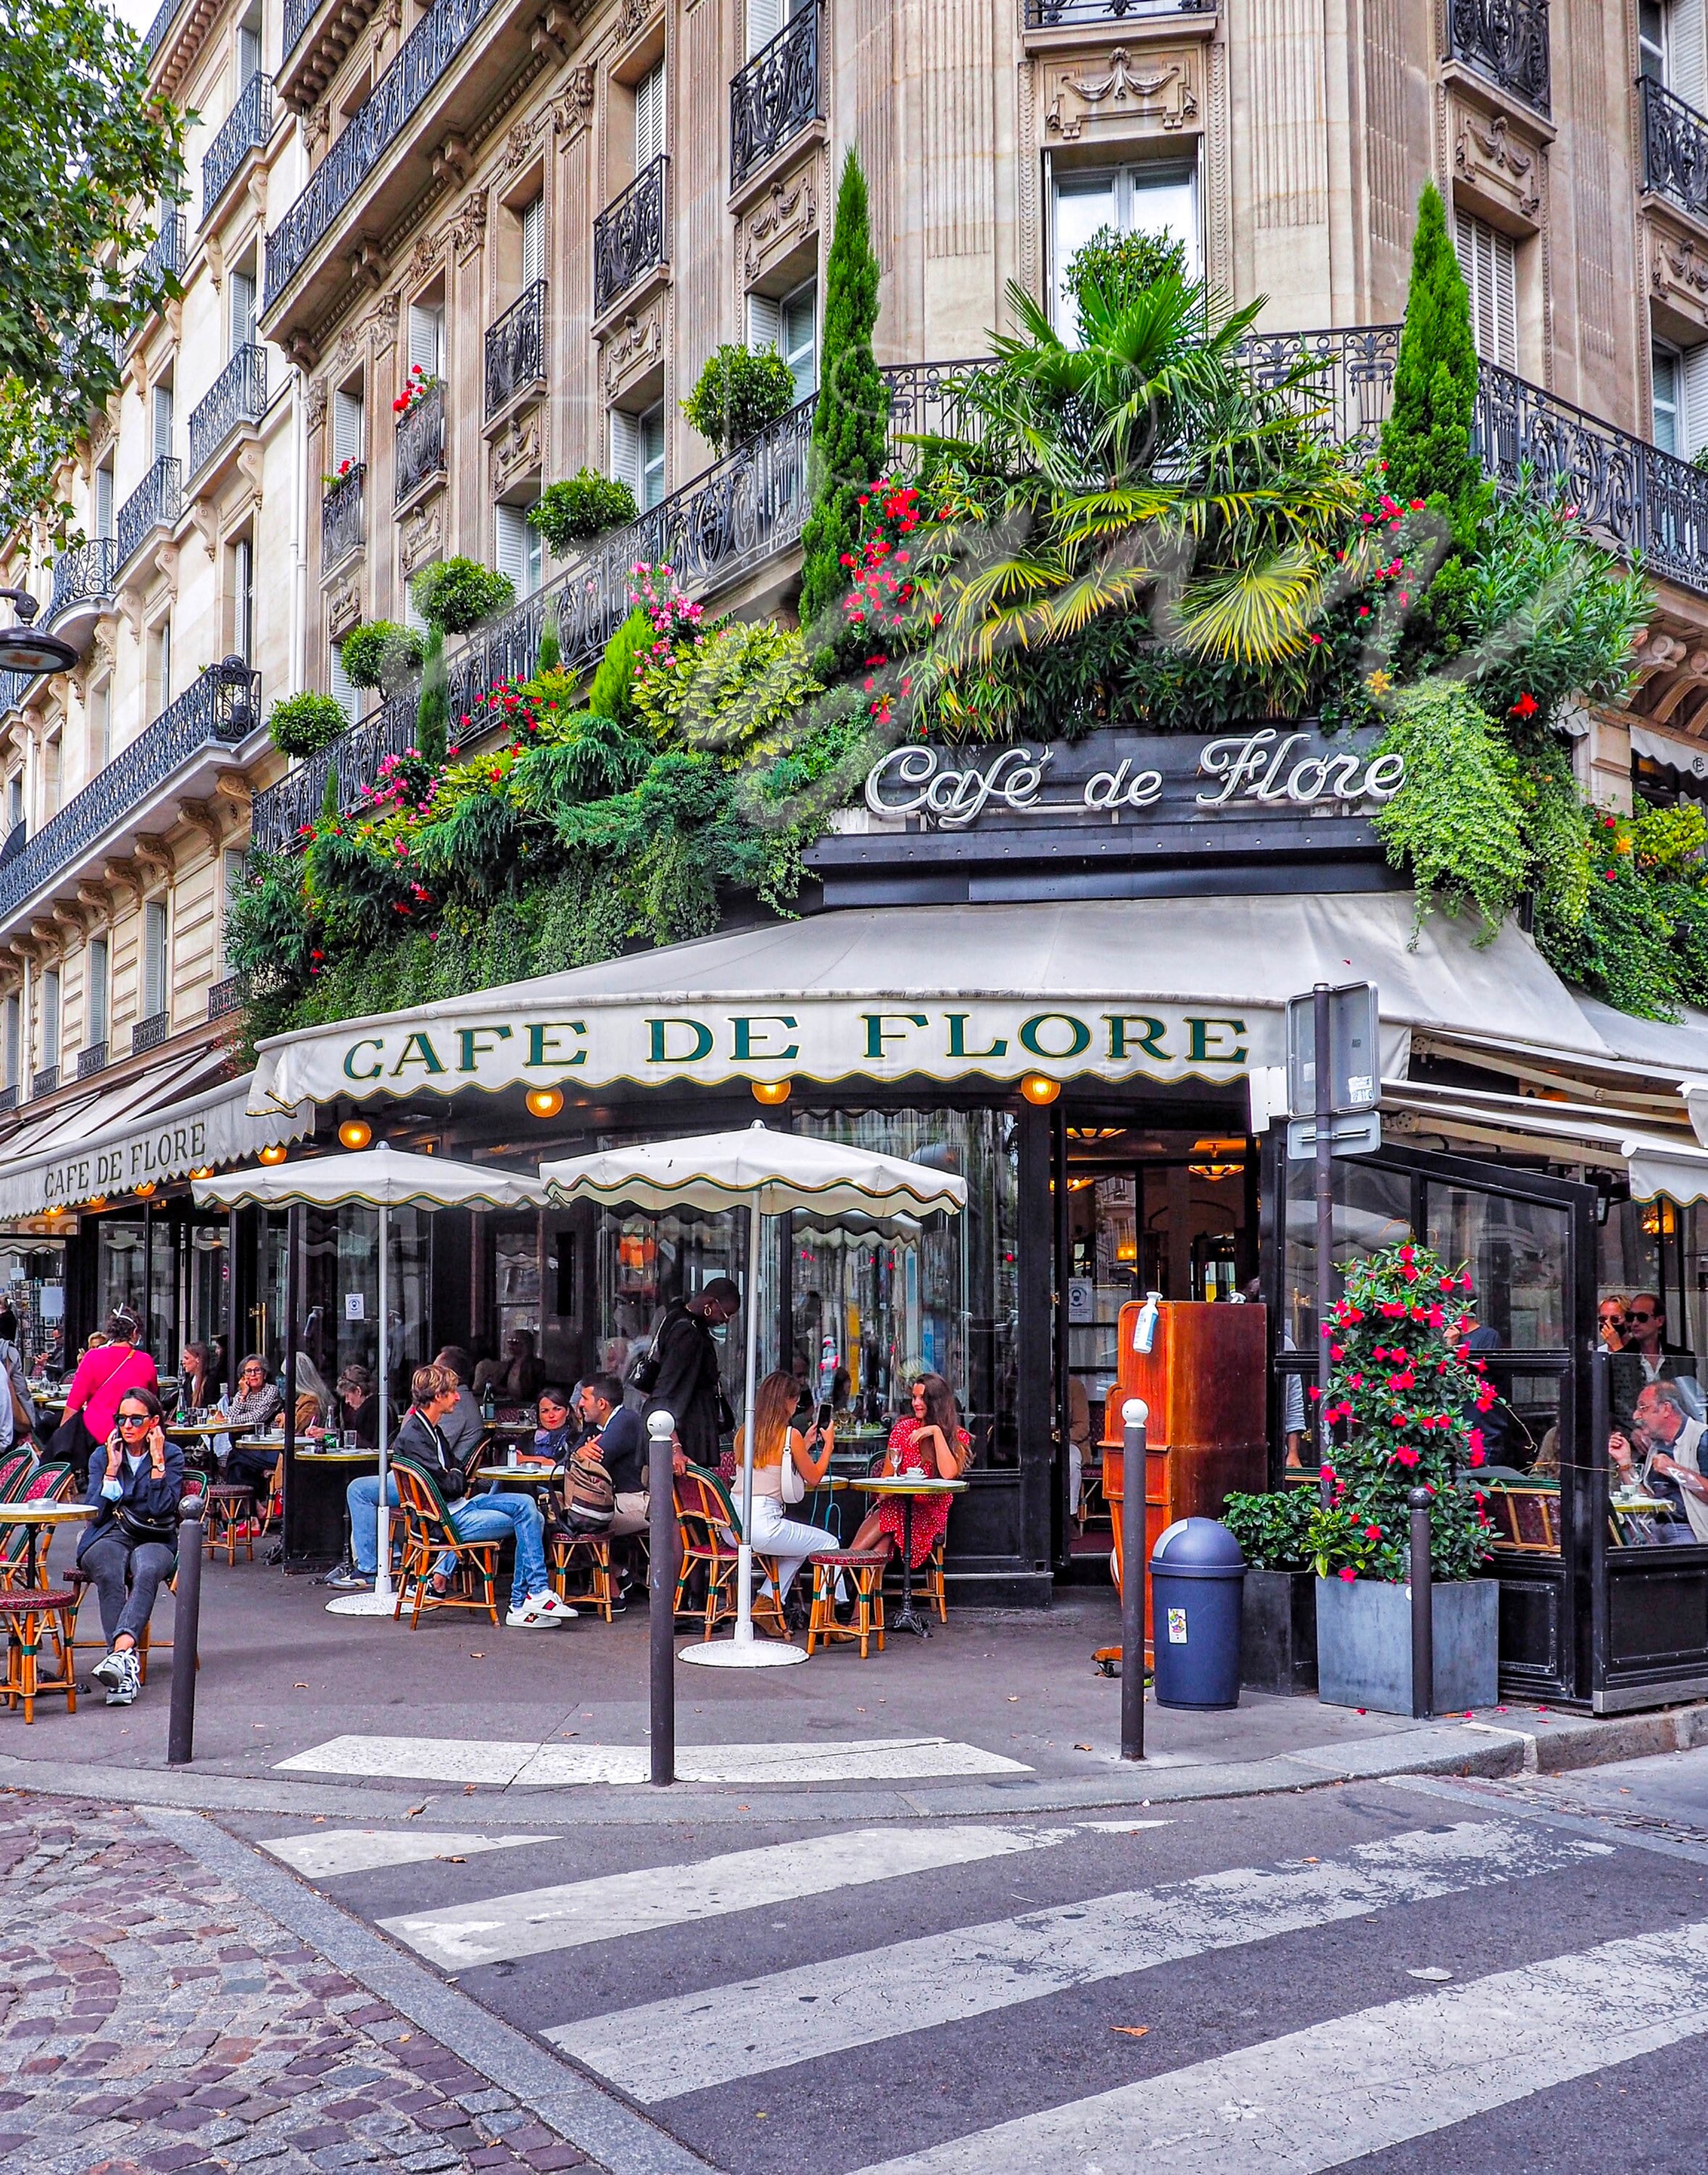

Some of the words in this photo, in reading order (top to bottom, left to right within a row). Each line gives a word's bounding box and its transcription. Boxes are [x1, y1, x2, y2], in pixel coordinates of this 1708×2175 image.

[864, 745, 1054, 828] Café
[1083, 758, 1163, 808] de
[1195, 727, 1406, 806] Flore
[343, 1019, 590, 1080] CAFE
[644, 1016, 800, 1064] DE
[861, 1013, 1248, 1064] FLORE
[44, 1160, 89, 1198] CAFE
[97, 1151, 123, 1184] DE
[130, 1122, 205, 1175] FLORE
